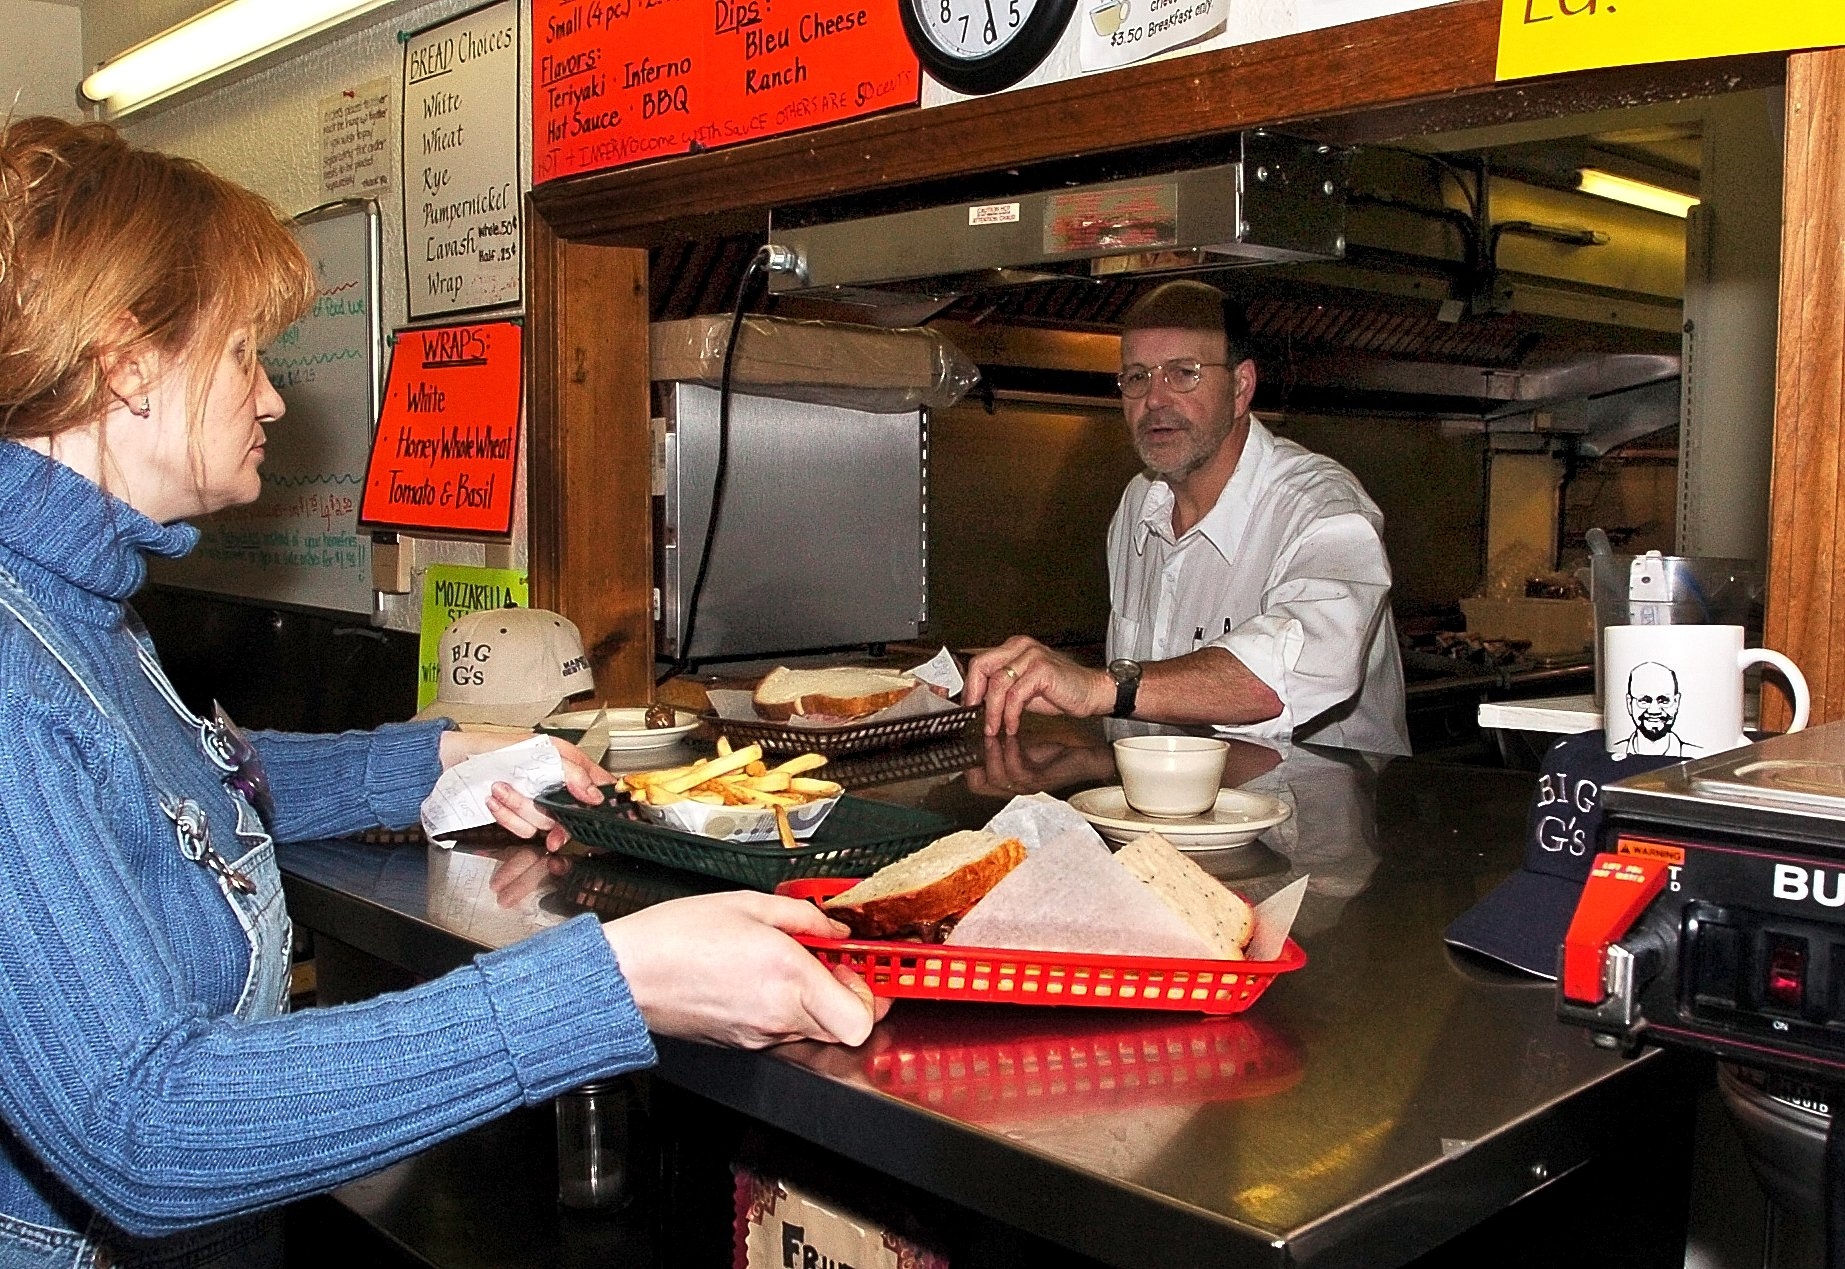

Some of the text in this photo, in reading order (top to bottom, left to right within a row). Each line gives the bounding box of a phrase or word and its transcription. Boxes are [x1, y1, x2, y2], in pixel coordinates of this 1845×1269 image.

[546, 6, 582, 43] Small
[941, 0, 951, 23] 8
[958, 15, 970, 43] 7
[1009, 0, 1020, 27] 5
[1110, 26, 1143, 46] $3.50
[1147, 6, 1193, 37] Breakfast
[745, 10, 868, 60] Bleu Cheese
[409, 27, 512, 80] BREAD Choices
[541, 48, 602, 83] Flavors:
[547, 57, 693, 112] Teriyaki Inferno
[745, 56, 807, 96] Ranch
[423, 91, 462, 120] White
[547, 84, 690, 145] Hot Sauce BBQ
[776, 95, 818, 126] OTHERS
[821, 92, 848, 113] ARE
[422, 123, 464, 156] Wheat
[422, 167, 451, 197] Rye
[422, 182, 511, 229] Pumpernickel
[426, 227, 478, 262] Lavash
[427, 271, 464, 303] Wrap
[422, 328, 491, 361] WRAPS:
[407, 381, 446, 413] White
[396, 425, 513, 468] Honey Whole Wheat
[388, 469, 436, 506] Tomato
[455, 472, 495, 509] Basil
[435, 579, 514, 610] MOZZARELLA
[452, 641, 492, 663] BIG
[452, 664, 485, 686] G's
[1537, 772, 1598, 813] BIG
[1537, 815, 1586, 856] G's
